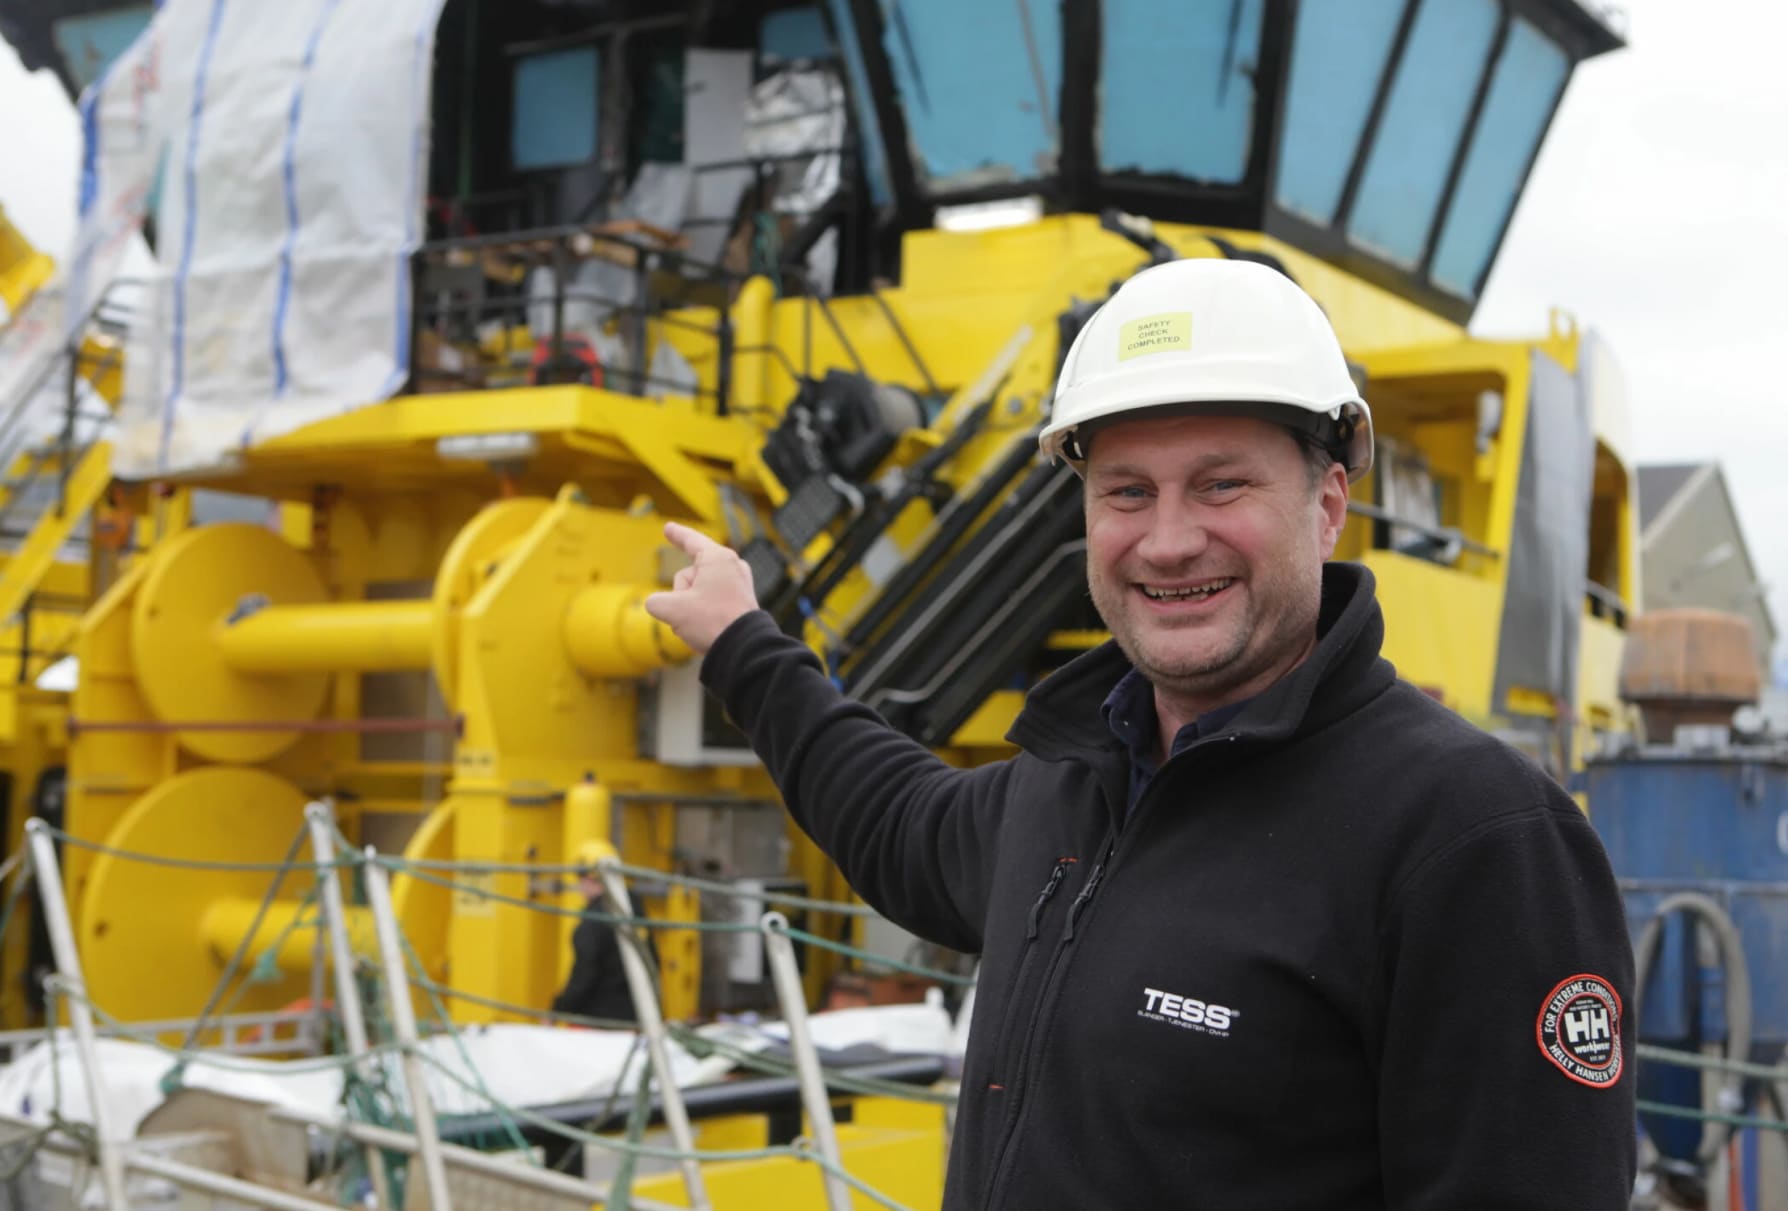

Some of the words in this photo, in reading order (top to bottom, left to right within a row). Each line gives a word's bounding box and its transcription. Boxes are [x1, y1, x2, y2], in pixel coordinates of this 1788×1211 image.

[1138, 320, 1170, 331] SAFETY
[1138, 328, 1168, 339] CHECK
[1127, 336, 1180, 350] COMPLETED
[1144, 987, 1232, 1030] TESS
[1549, 981, 1584, 1013] EXTREME
[1544, 1011, 1556, 1033] FOR
[1563, 1008, 1611, 1043] HH
[1548, 1043, 1575, 1069] HELLY
[1575, 1066, 1609, 1082] HANSEN
